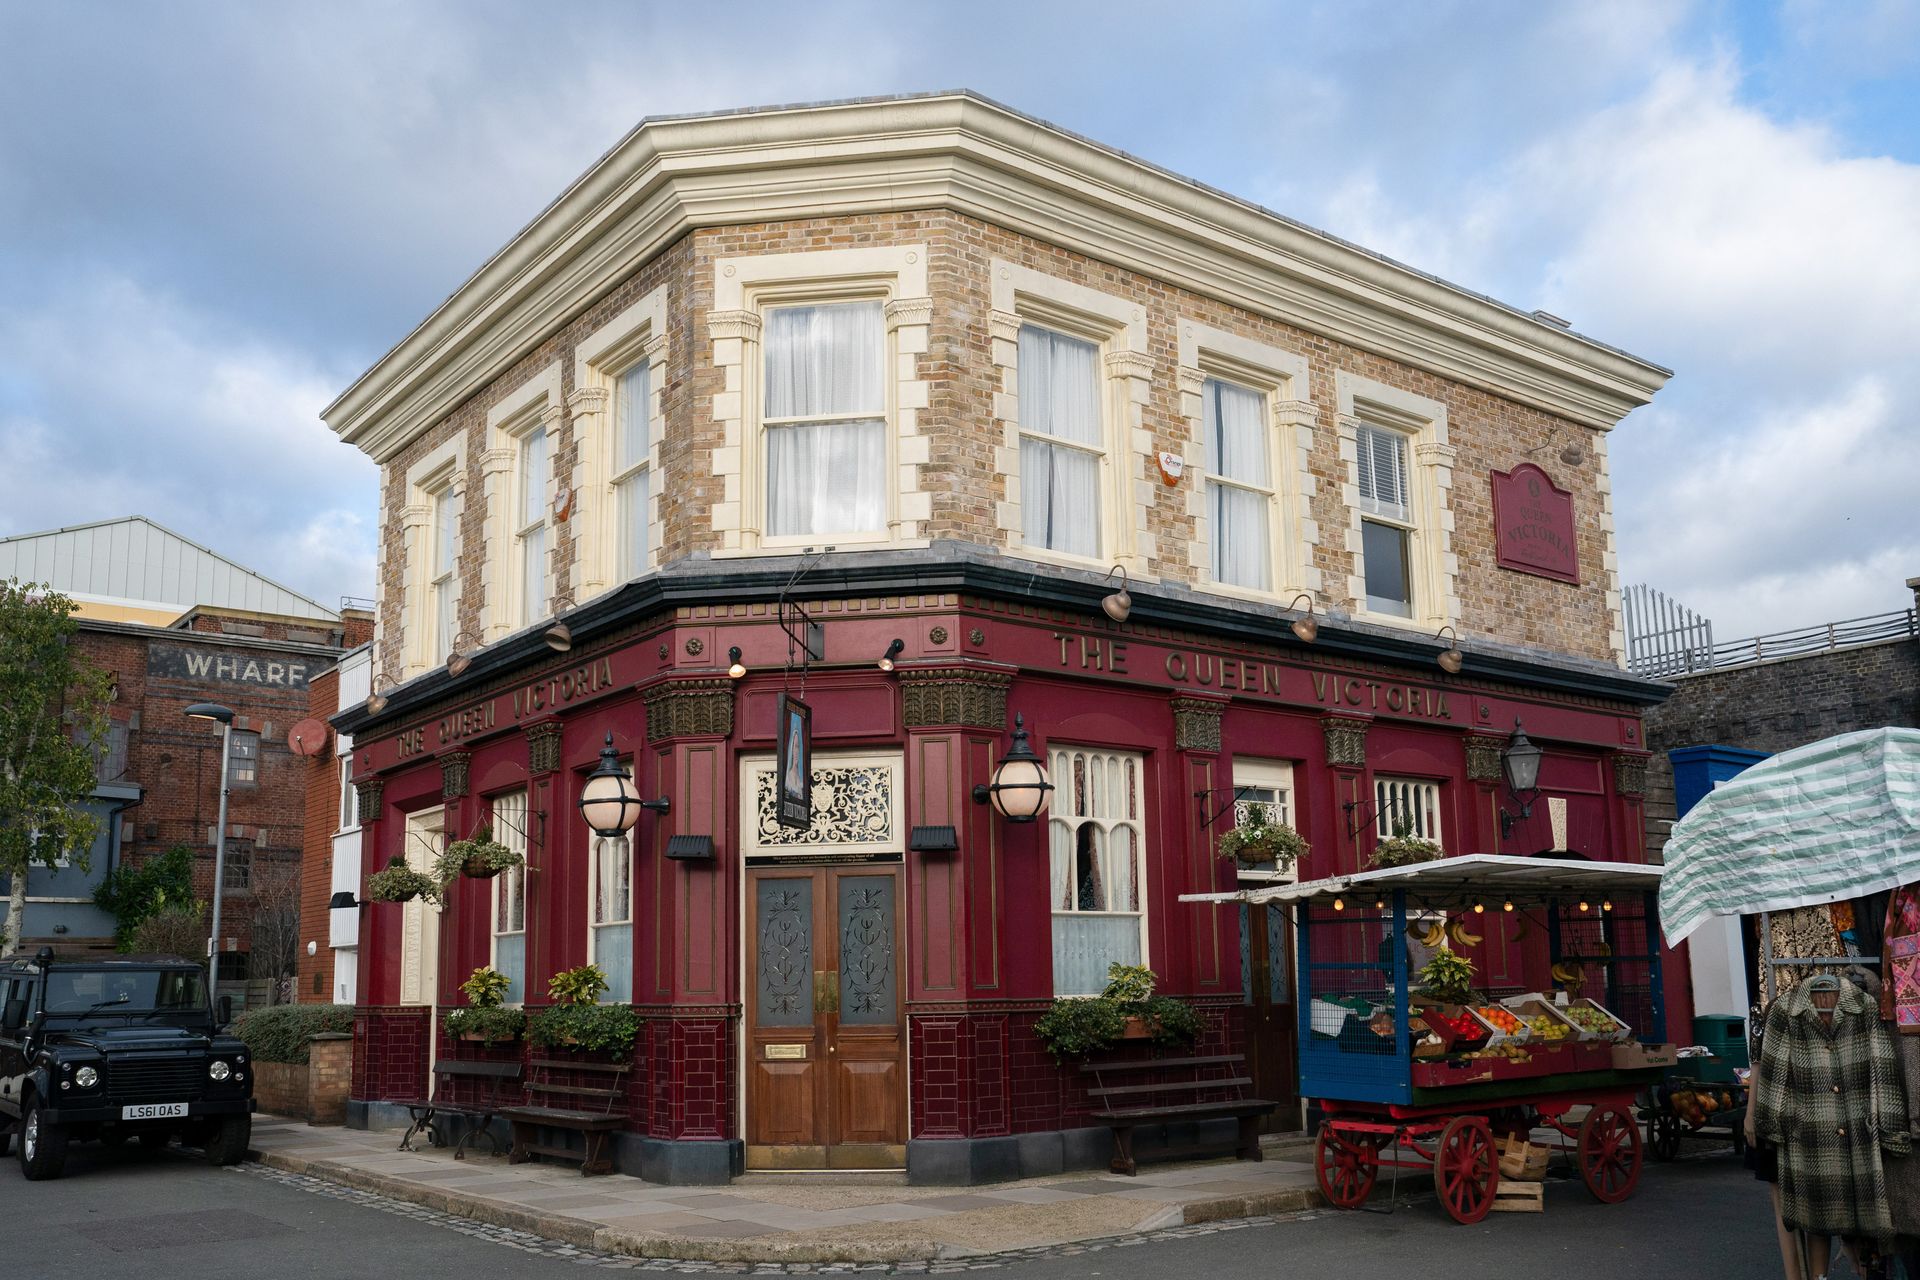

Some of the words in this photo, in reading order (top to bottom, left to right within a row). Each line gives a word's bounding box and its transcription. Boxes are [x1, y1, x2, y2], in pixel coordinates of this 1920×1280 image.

[1508, 524, 1569, 558] VICTORIA
[185, 653, 307, 686] WHARF
[1053, 632, 1129, 675] THE
[1165, 652, 1281, 695] QUEEN
[1312, 671, 1452, 720] VICTORIA
[397, 725, 425, 759] THE
[438, 700, 496, 744] QUEEN
[512, 656, 613, 719] VICTORIA
[130, 1106, 156, 1118] LS61
[159, 1104, 182, 1116] OAS
